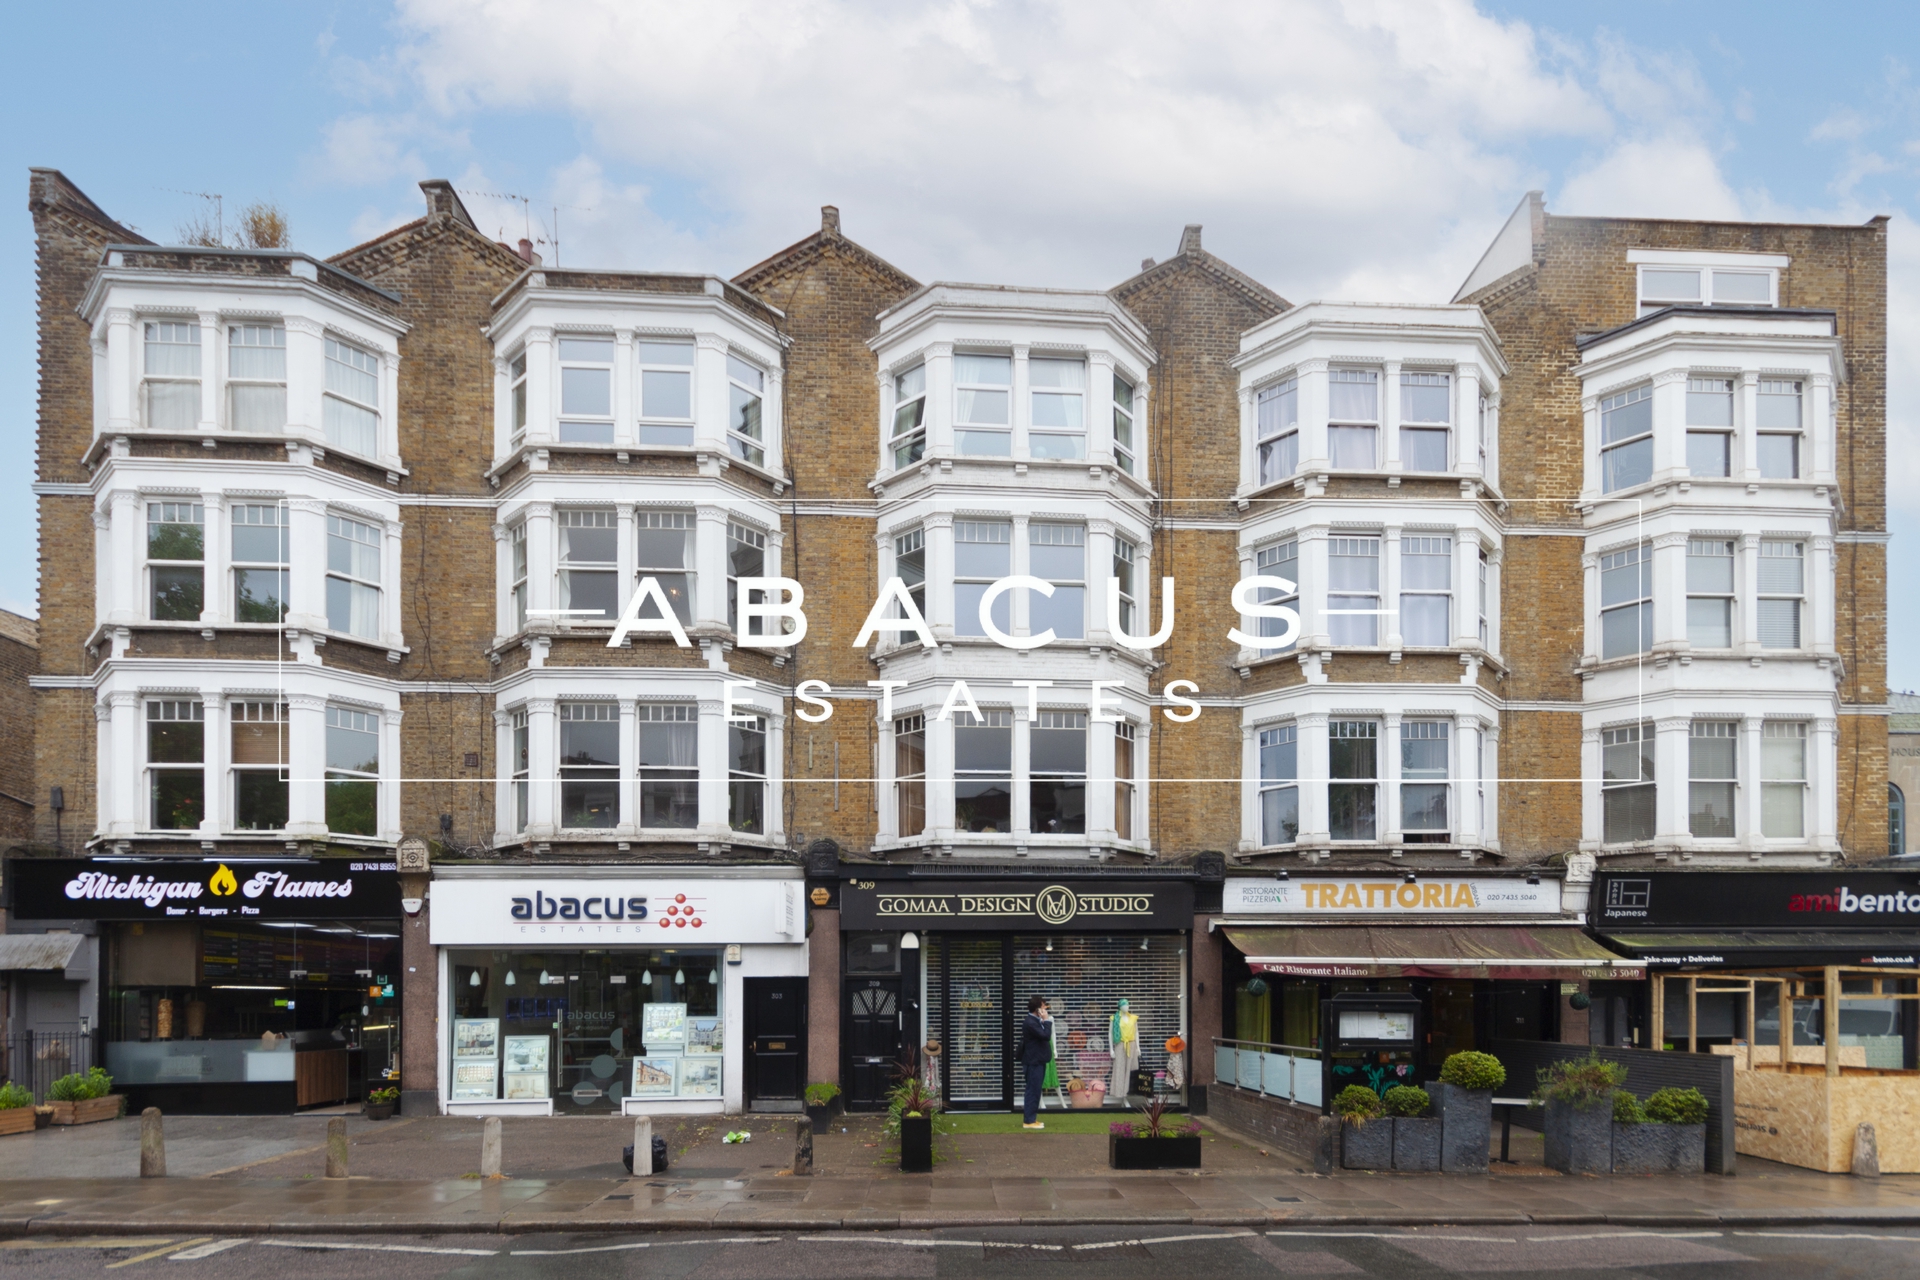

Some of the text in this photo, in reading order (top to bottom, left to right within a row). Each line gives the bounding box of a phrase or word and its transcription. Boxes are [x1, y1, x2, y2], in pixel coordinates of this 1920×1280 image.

[350, 863, 363, 871] 020
[364, 863, 379, 871] 7431
[65, 871, 352, 908] Michigan Flames
[858, 881, 875, 890] 309
[1242, 887, 1288, 895] RISTORANTE
[1300, 883, 1476, 909] TRATTORIA
[1242, 895, 1277, 903] PIZZERIA
[1788, 886, 1920, 913] amibento
[511, 890, 648, 920] abacus
[879, 897, 1150, 913] GOMAA DESIGN STUDIO
[166, 906, 188, 915] Doner
[199, 906, 228, 916] Burgers
[241, 905, 260, 914] Pizza
[1604, 909, 1648, 919] Japanese
[520, 925, 642, 933] ESTATES
[1643, 956, 1681, 965] Take-away
[1860, 955, 1914, 964] amibento.co.uk
[1286, 965, 1332, 975] Ristorante
[1333, 966, 1369, 976] Italiano
[1582, 969, 1597, 977] 020
[1619, 969, 1640, 977] 5040
[567, 1009, 616, 1020] abacus
